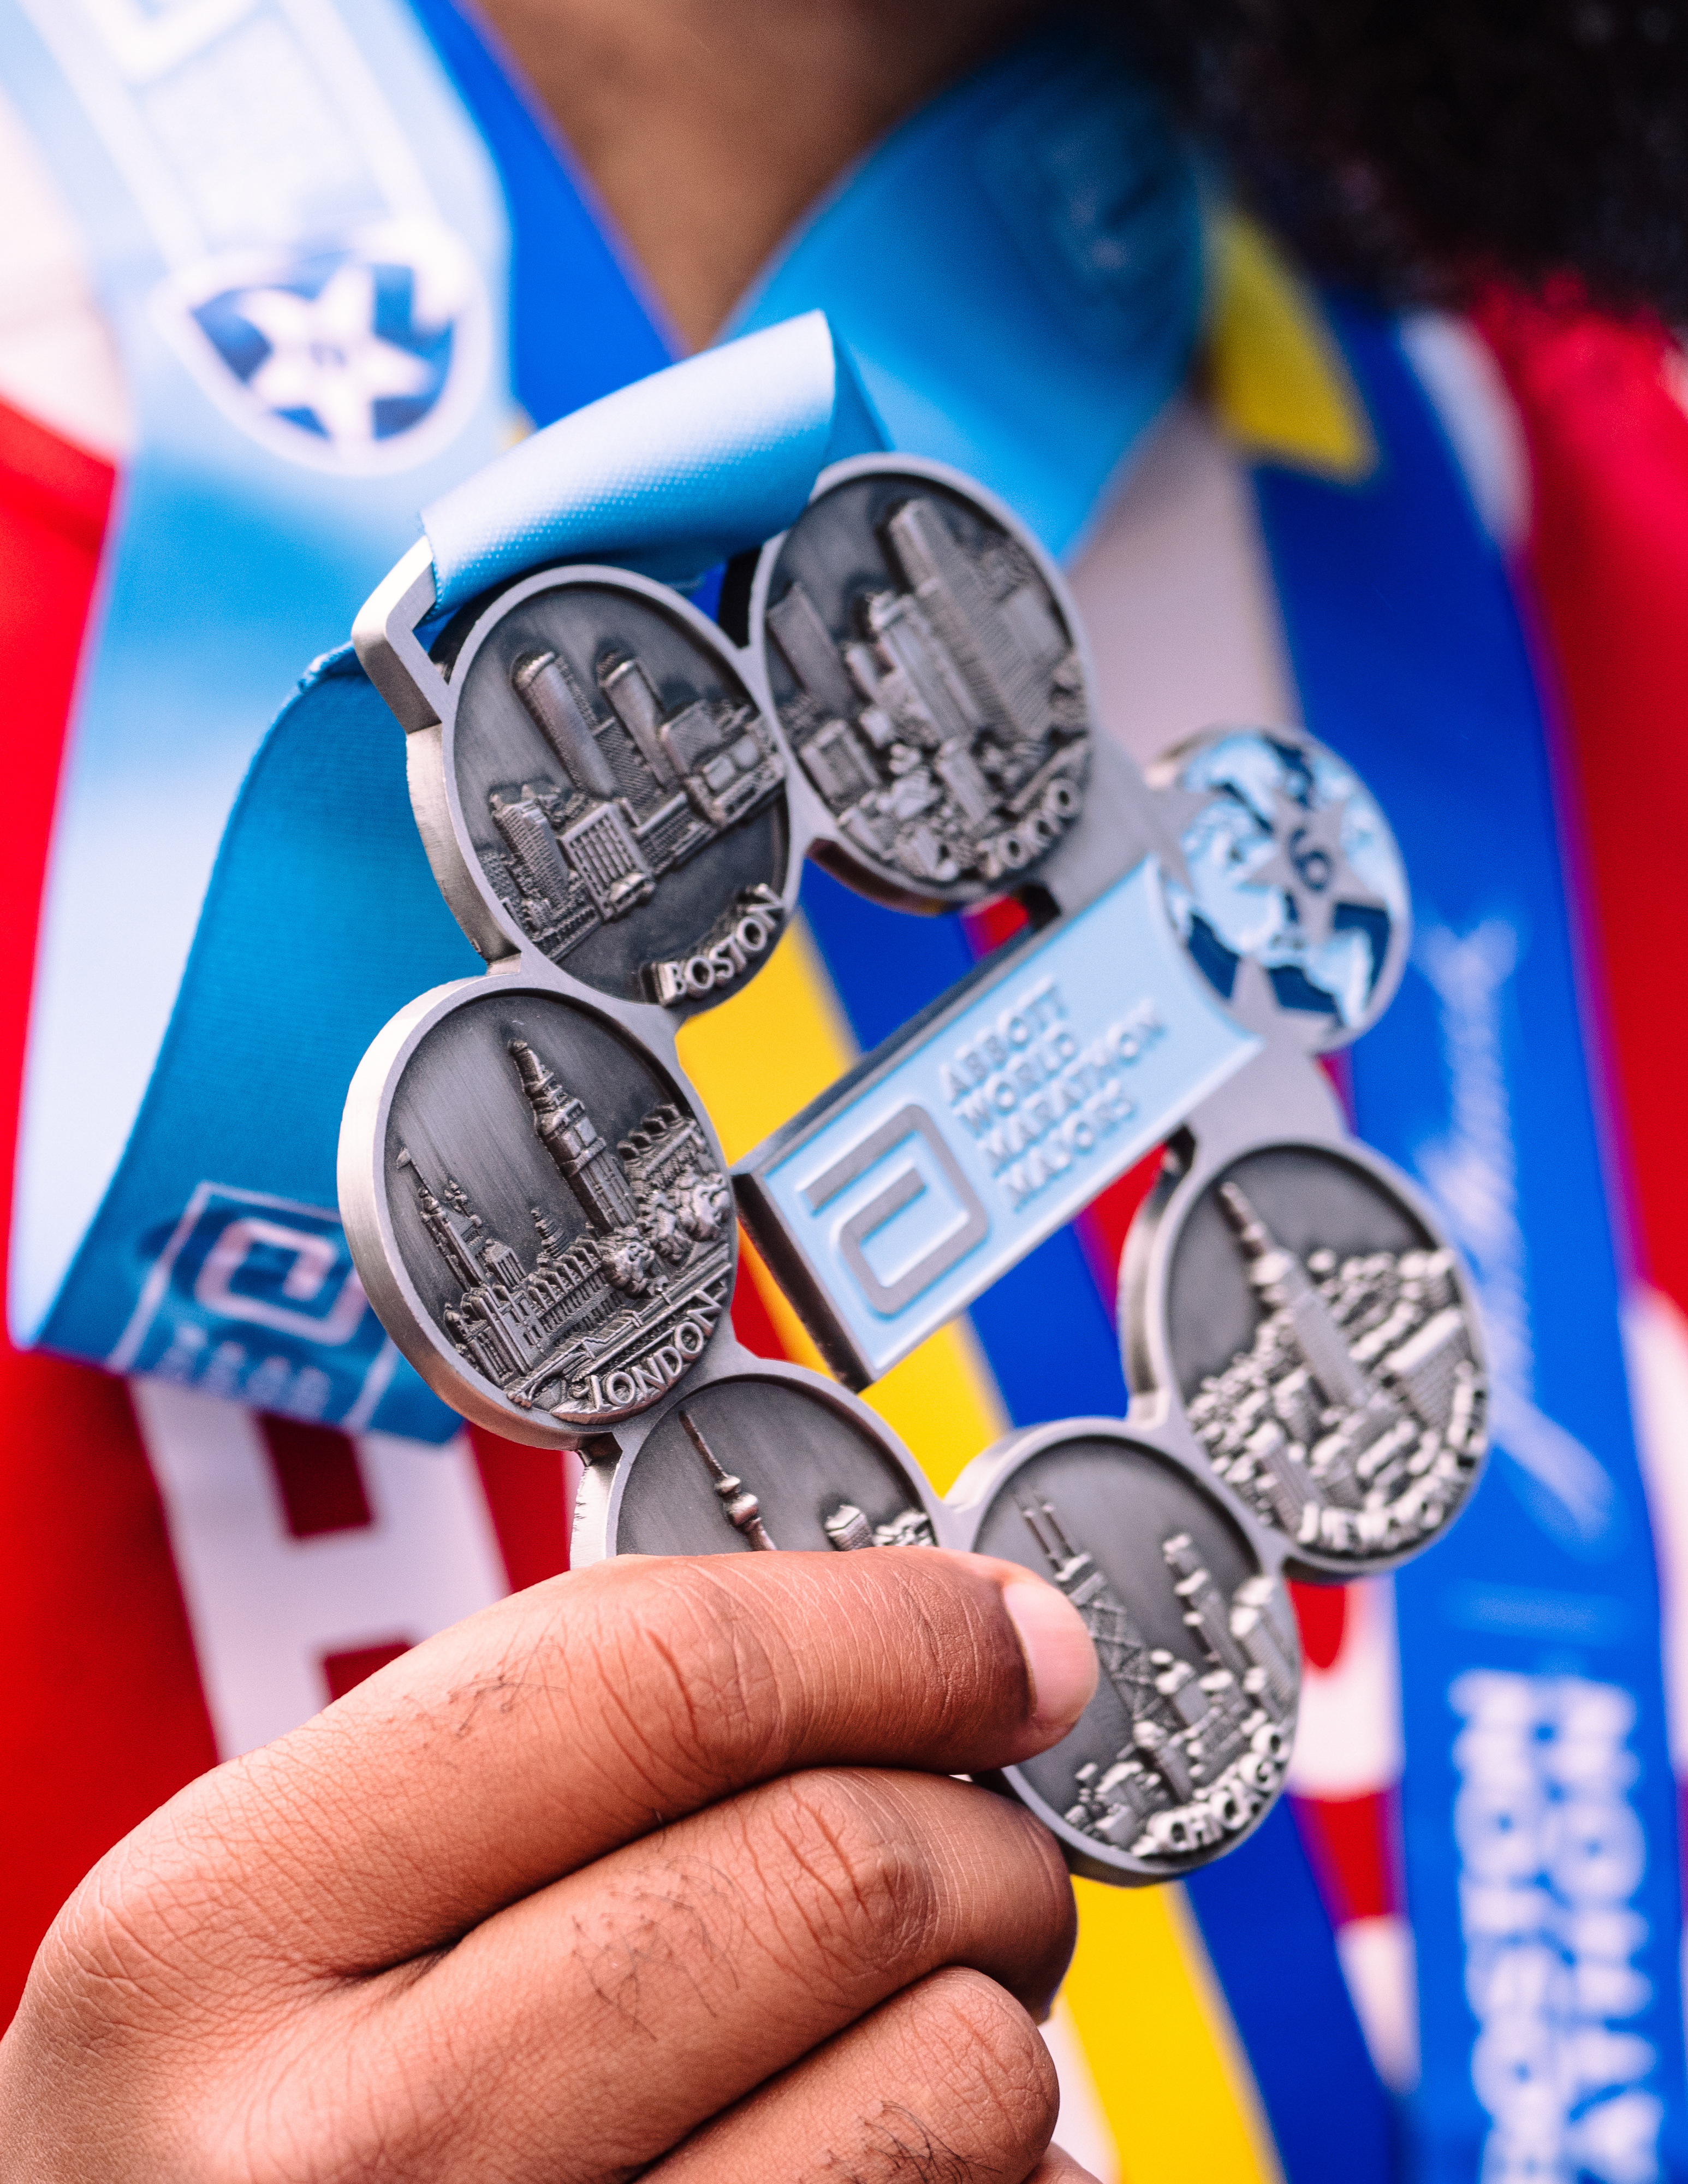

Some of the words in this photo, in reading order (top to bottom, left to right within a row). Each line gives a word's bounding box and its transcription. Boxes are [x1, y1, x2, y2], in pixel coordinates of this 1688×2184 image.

[657, 883, 787, 1001] BOSTON
[940, 976, 1068, 1106] ABBOTT
[953, 1021, 1078, 1138] WORLD
[977, 998, 1169, 1177] MARATHON
[998, 1078, 1137, 1213] MAJORS
[590, 1289, 722, 1412] LONDON
[1148, 1724, 1291, 1850] CHICAGO
